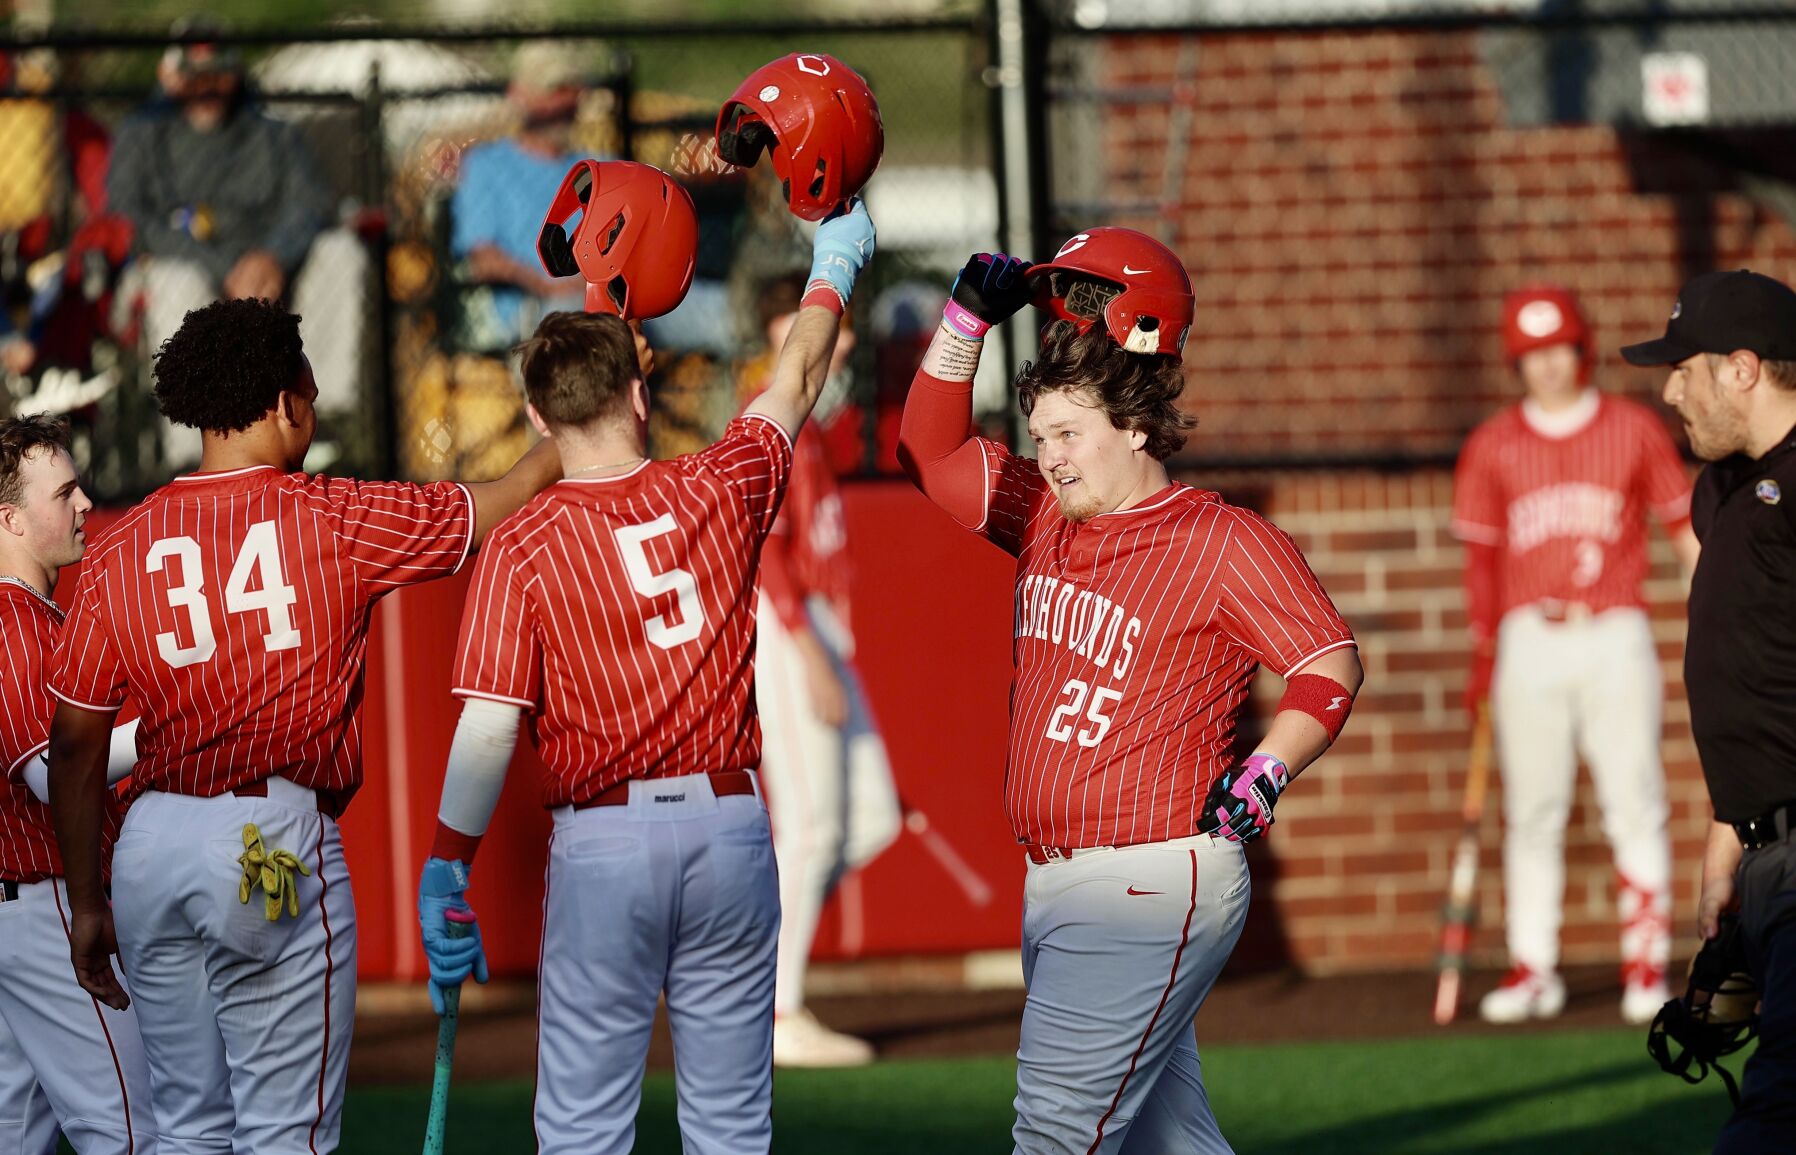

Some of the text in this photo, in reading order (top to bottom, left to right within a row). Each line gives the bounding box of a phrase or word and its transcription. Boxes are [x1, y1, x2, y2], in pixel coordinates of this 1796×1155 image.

[145, 519, 302, 669] 34
[614, 511, 705, 650] 5
[1046, 678, 1123, 748] 25
[654, 792, 686, 803] marucci
